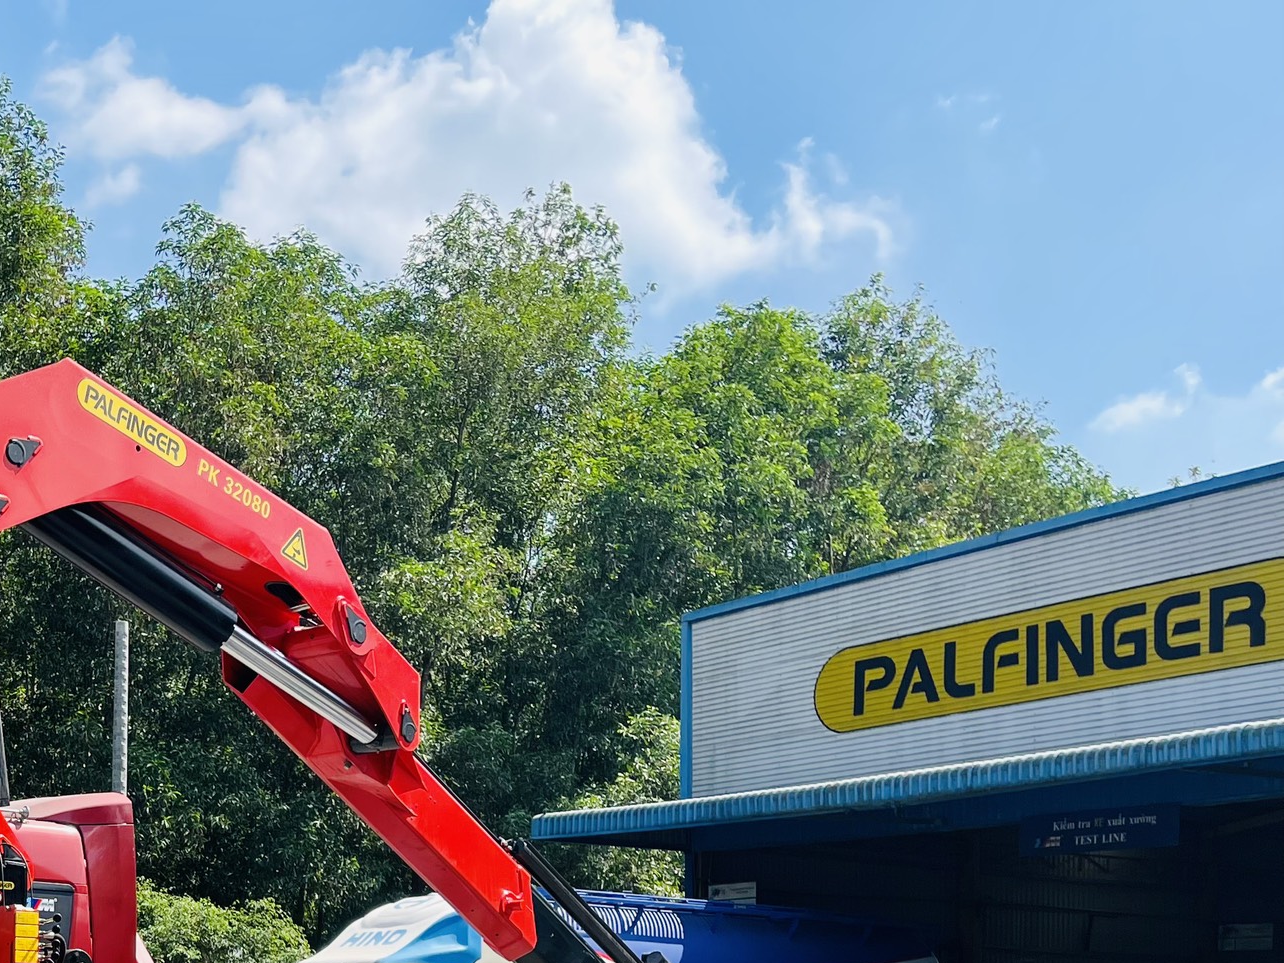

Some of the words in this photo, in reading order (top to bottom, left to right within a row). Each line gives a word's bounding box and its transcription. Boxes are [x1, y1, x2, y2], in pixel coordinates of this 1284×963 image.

[84, 385, 180, 461] PALFINGER
[198, 458, 221, 487] PK
[223, 476, 271, 519] 32080
[853, 581, 1266, 716] PALFINGER
[1075, 834, 1099, 846] TEST
[1102, 832, 1127, 844] LINE
[340, 929, 407, 948] HINO
